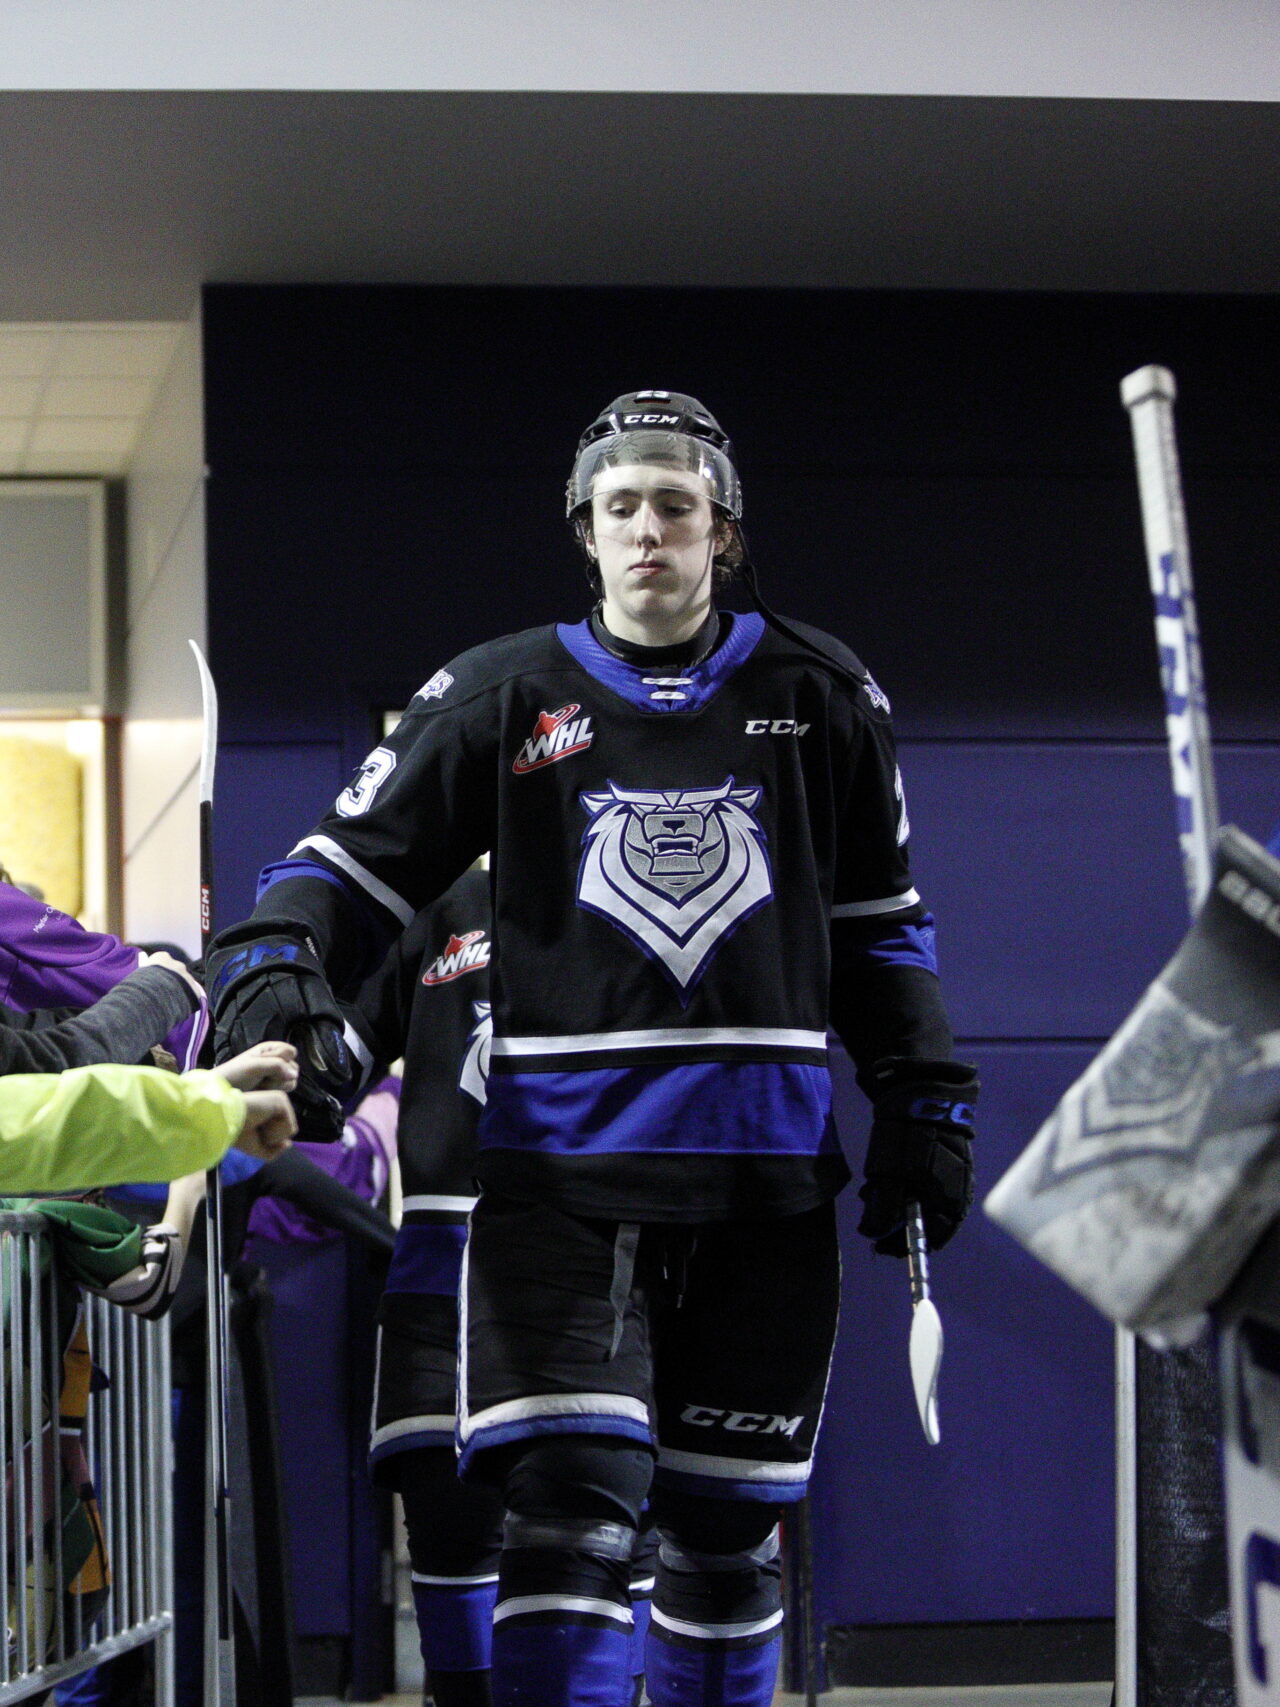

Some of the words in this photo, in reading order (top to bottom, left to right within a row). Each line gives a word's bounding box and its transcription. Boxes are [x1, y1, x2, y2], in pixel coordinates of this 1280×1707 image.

[623, 414, 680, 424] CCM
[525, 716, 594, 764] WHL
[744, 719, 811, 737] CCM
[201, 887, 210, 931] CCM
[436, 941, 491, 978] WHL
[680, 1402, 805, 1440] CCM
